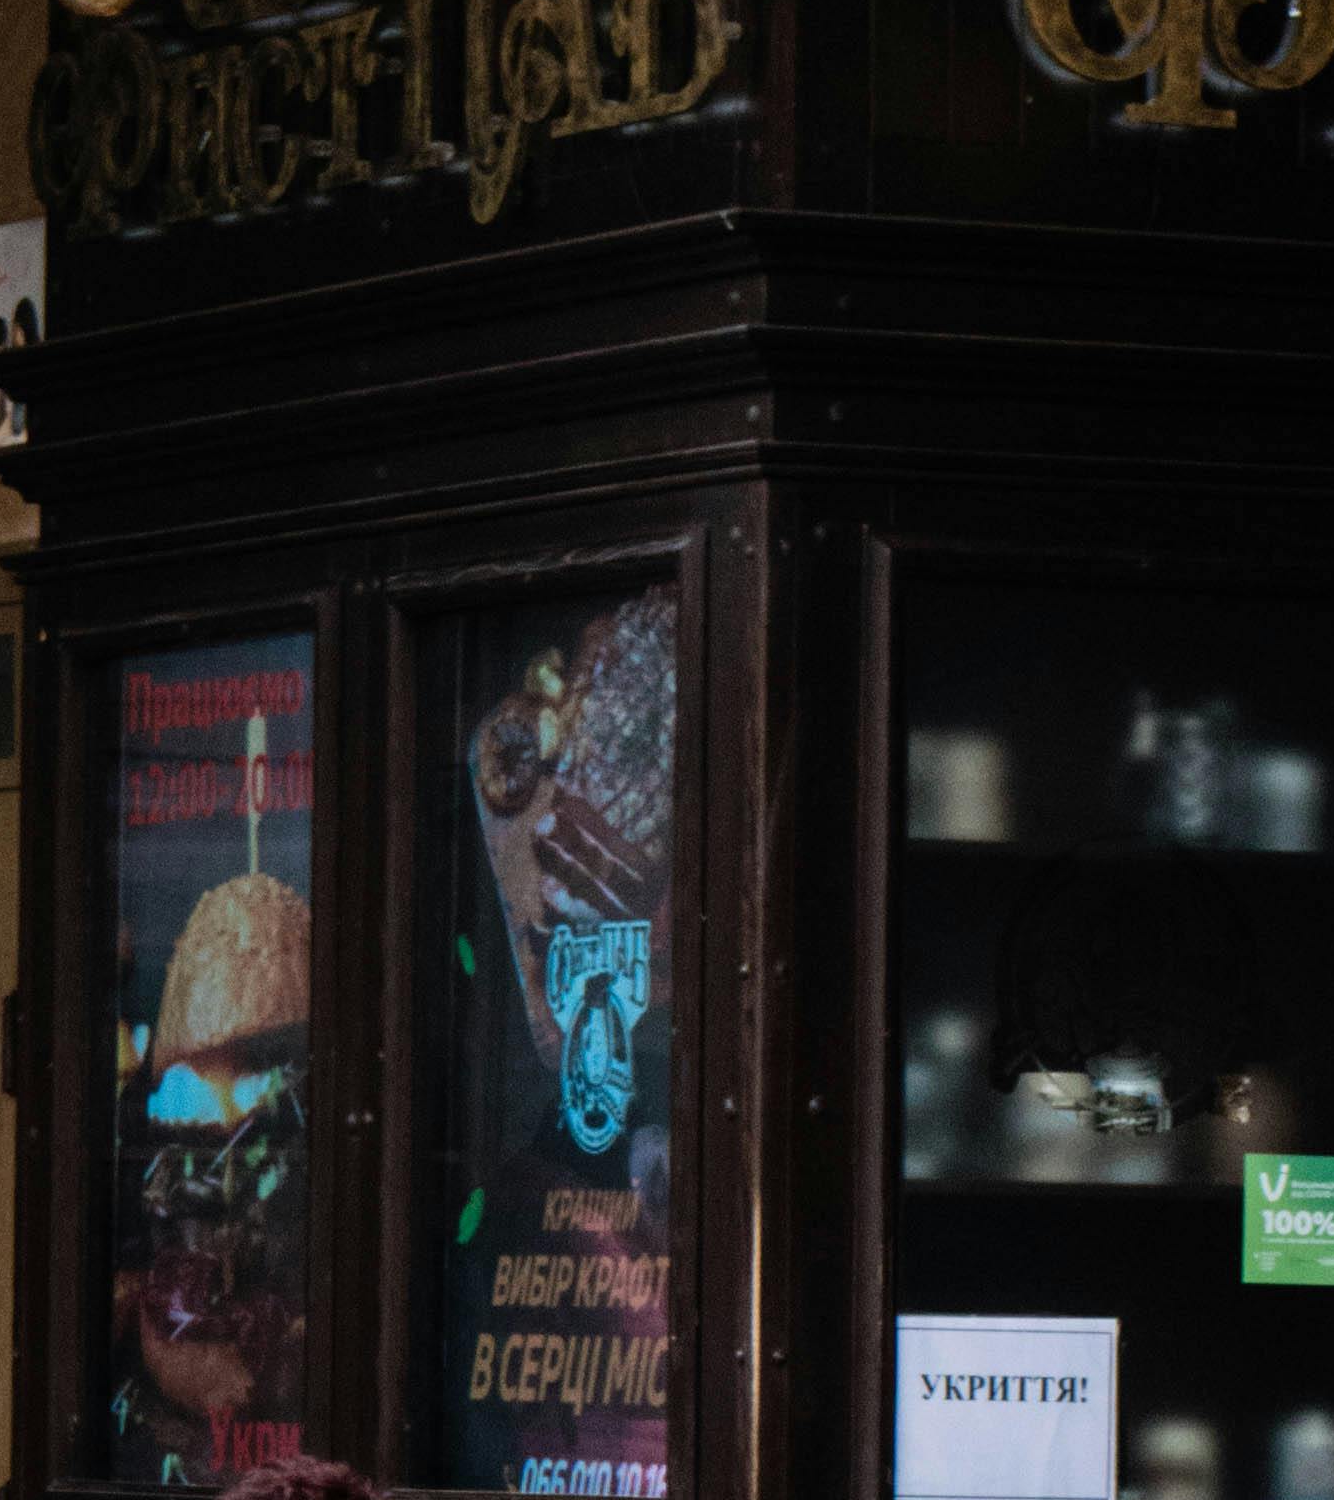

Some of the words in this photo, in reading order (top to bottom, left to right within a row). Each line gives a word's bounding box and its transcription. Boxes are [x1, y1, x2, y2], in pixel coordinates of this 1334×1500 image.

[491, 1253, 575, 1308] ВИБІР
[469, 1330, 496, 1401] В
[498, 1332, 602, 1418] СЕРЦІ
[920, 1372, 1089, 1403] УКРИТТЯ!
